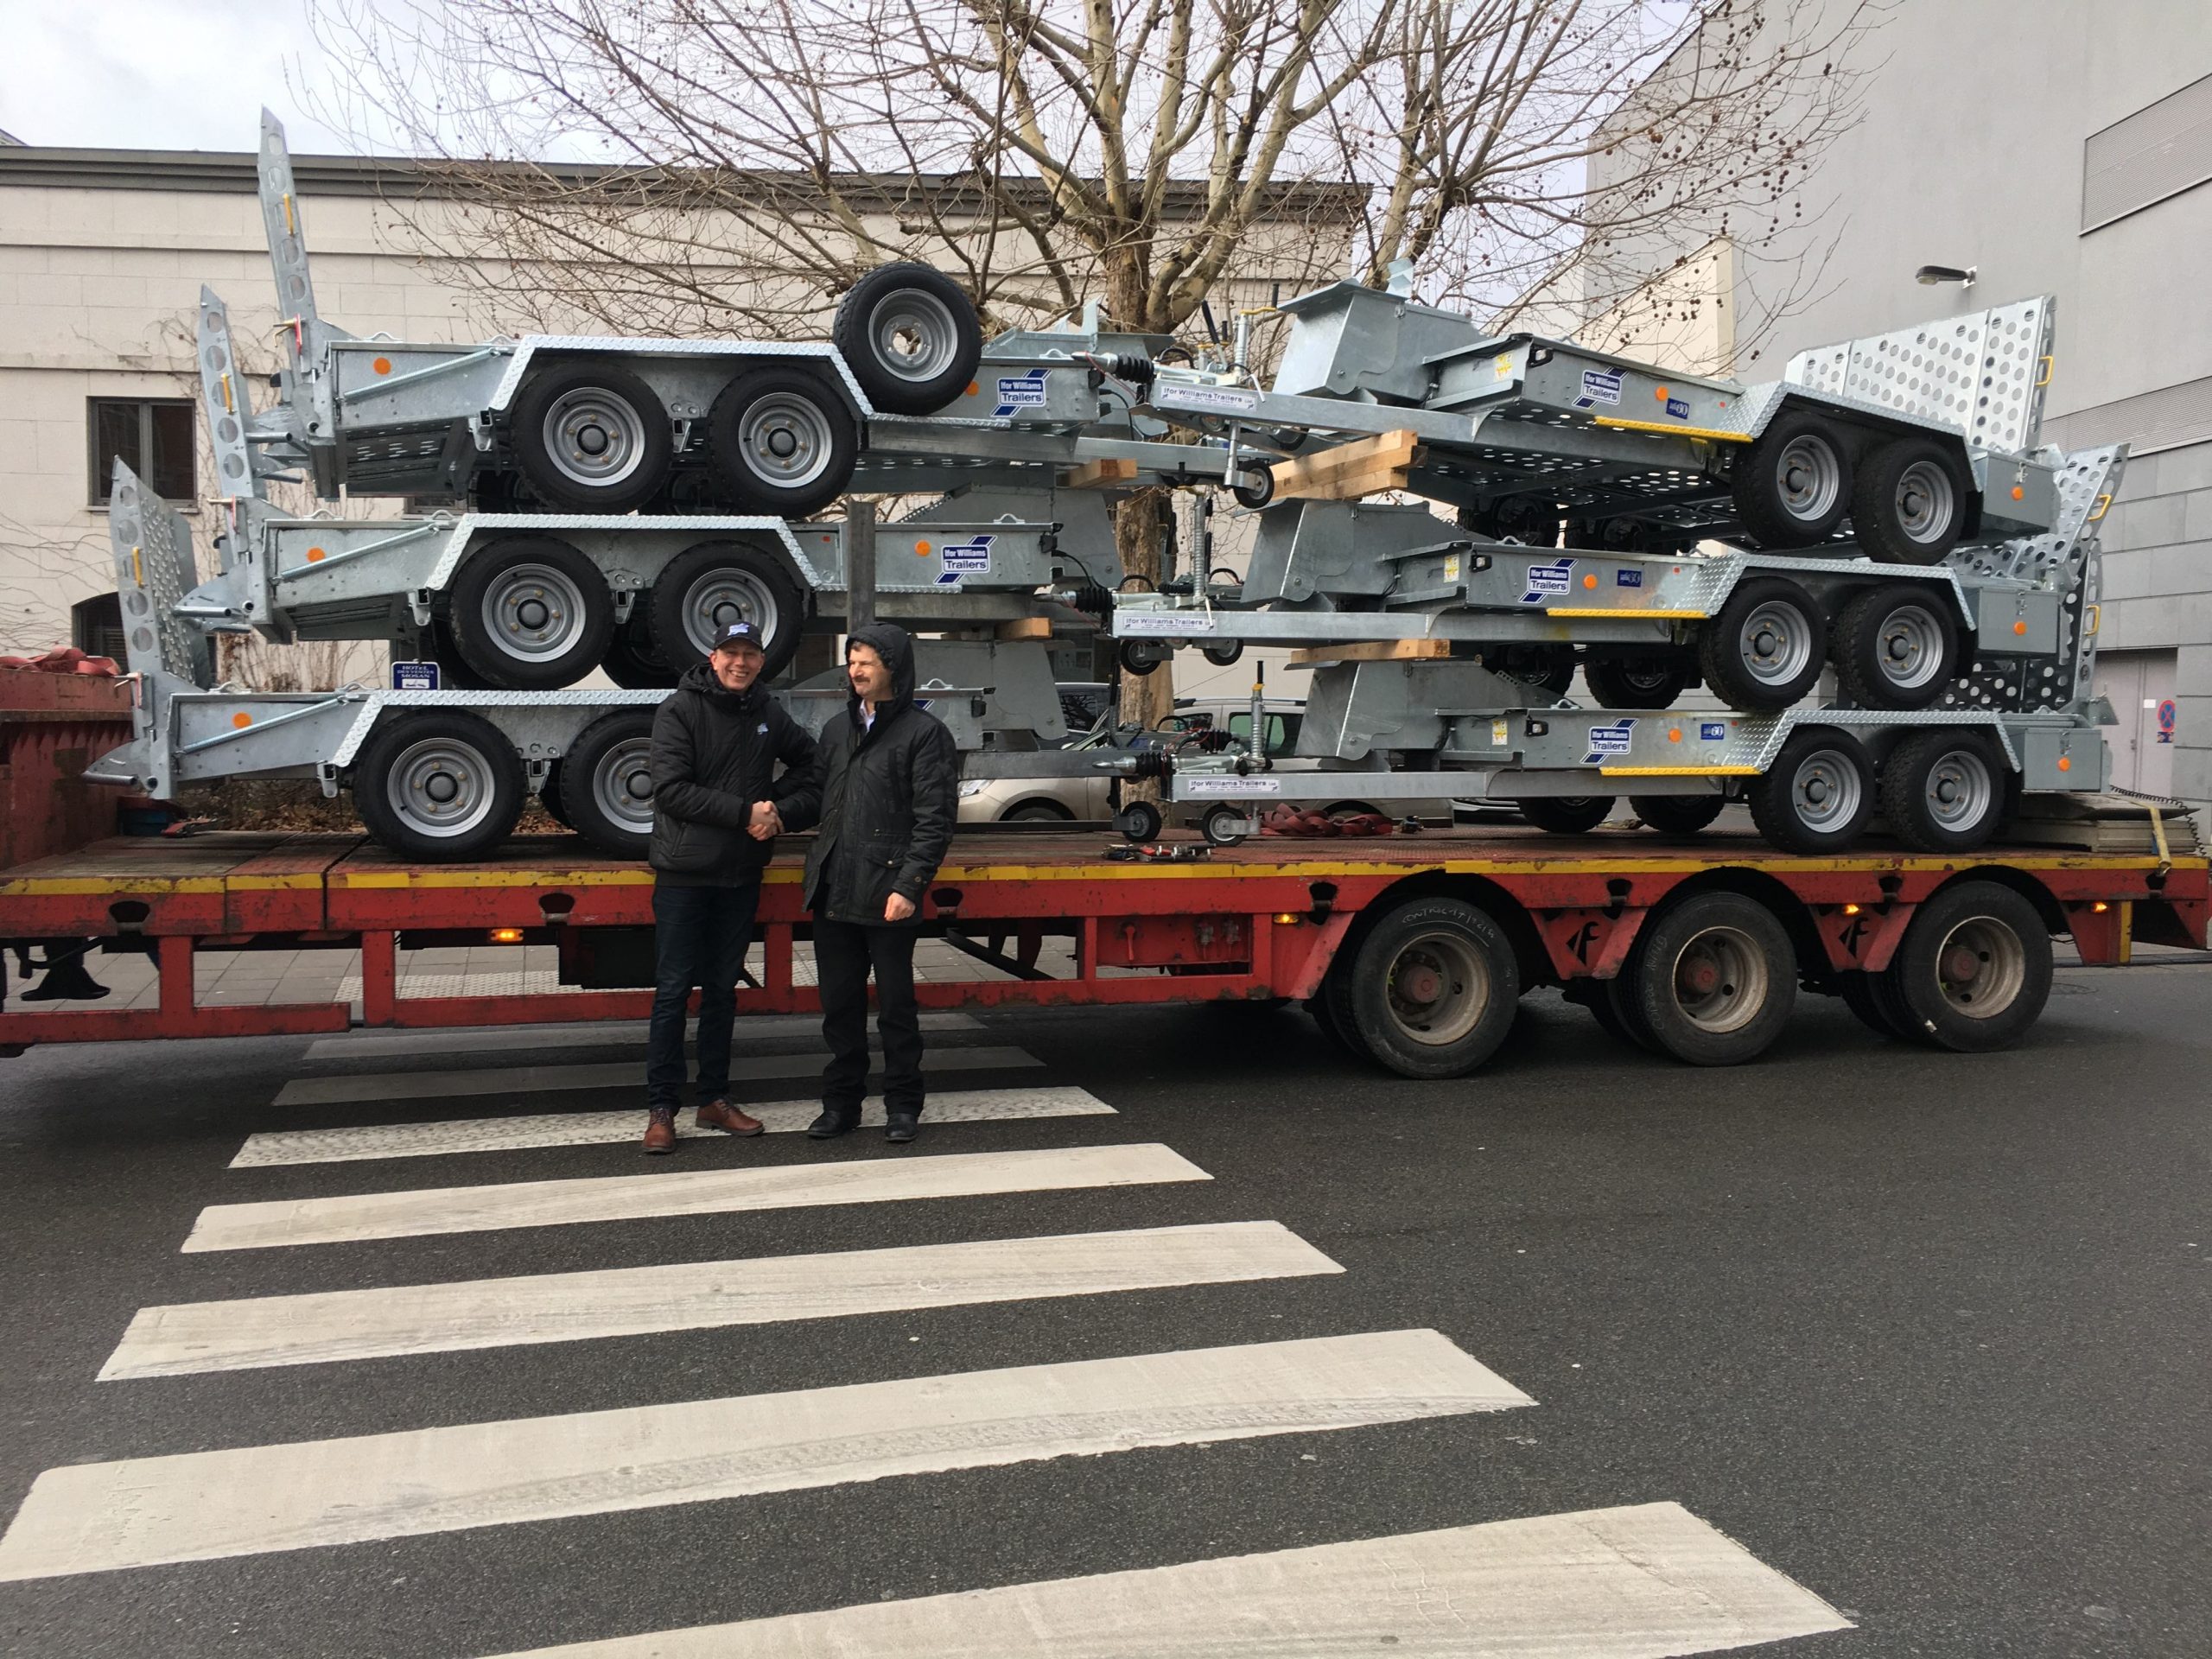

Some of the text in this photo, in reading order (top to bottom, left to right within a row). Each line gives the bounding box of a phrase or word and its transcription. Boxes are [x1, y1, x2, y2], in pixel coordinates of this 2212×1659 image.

[1013, 381, 1042, 390] Williams
[1595, 376, 1618, 389] Williams
[1001, 392, 1042, 402] Trailers
[1179, 390, 1212, 399] Williams
[1213, 393, 1243, 403] Trailers
[1585, 385, 1618, 401] Trailers
[957, 549, 987, 557] Williams
[945, 560, 987, 569] Trailers
[1541, 569, 1567, 579] Williams
[1530, 580, 1567, 590] Trailers
[1603, 730, 1628, 739] Williams
[1592, 741, 1627, 750] Trailers
